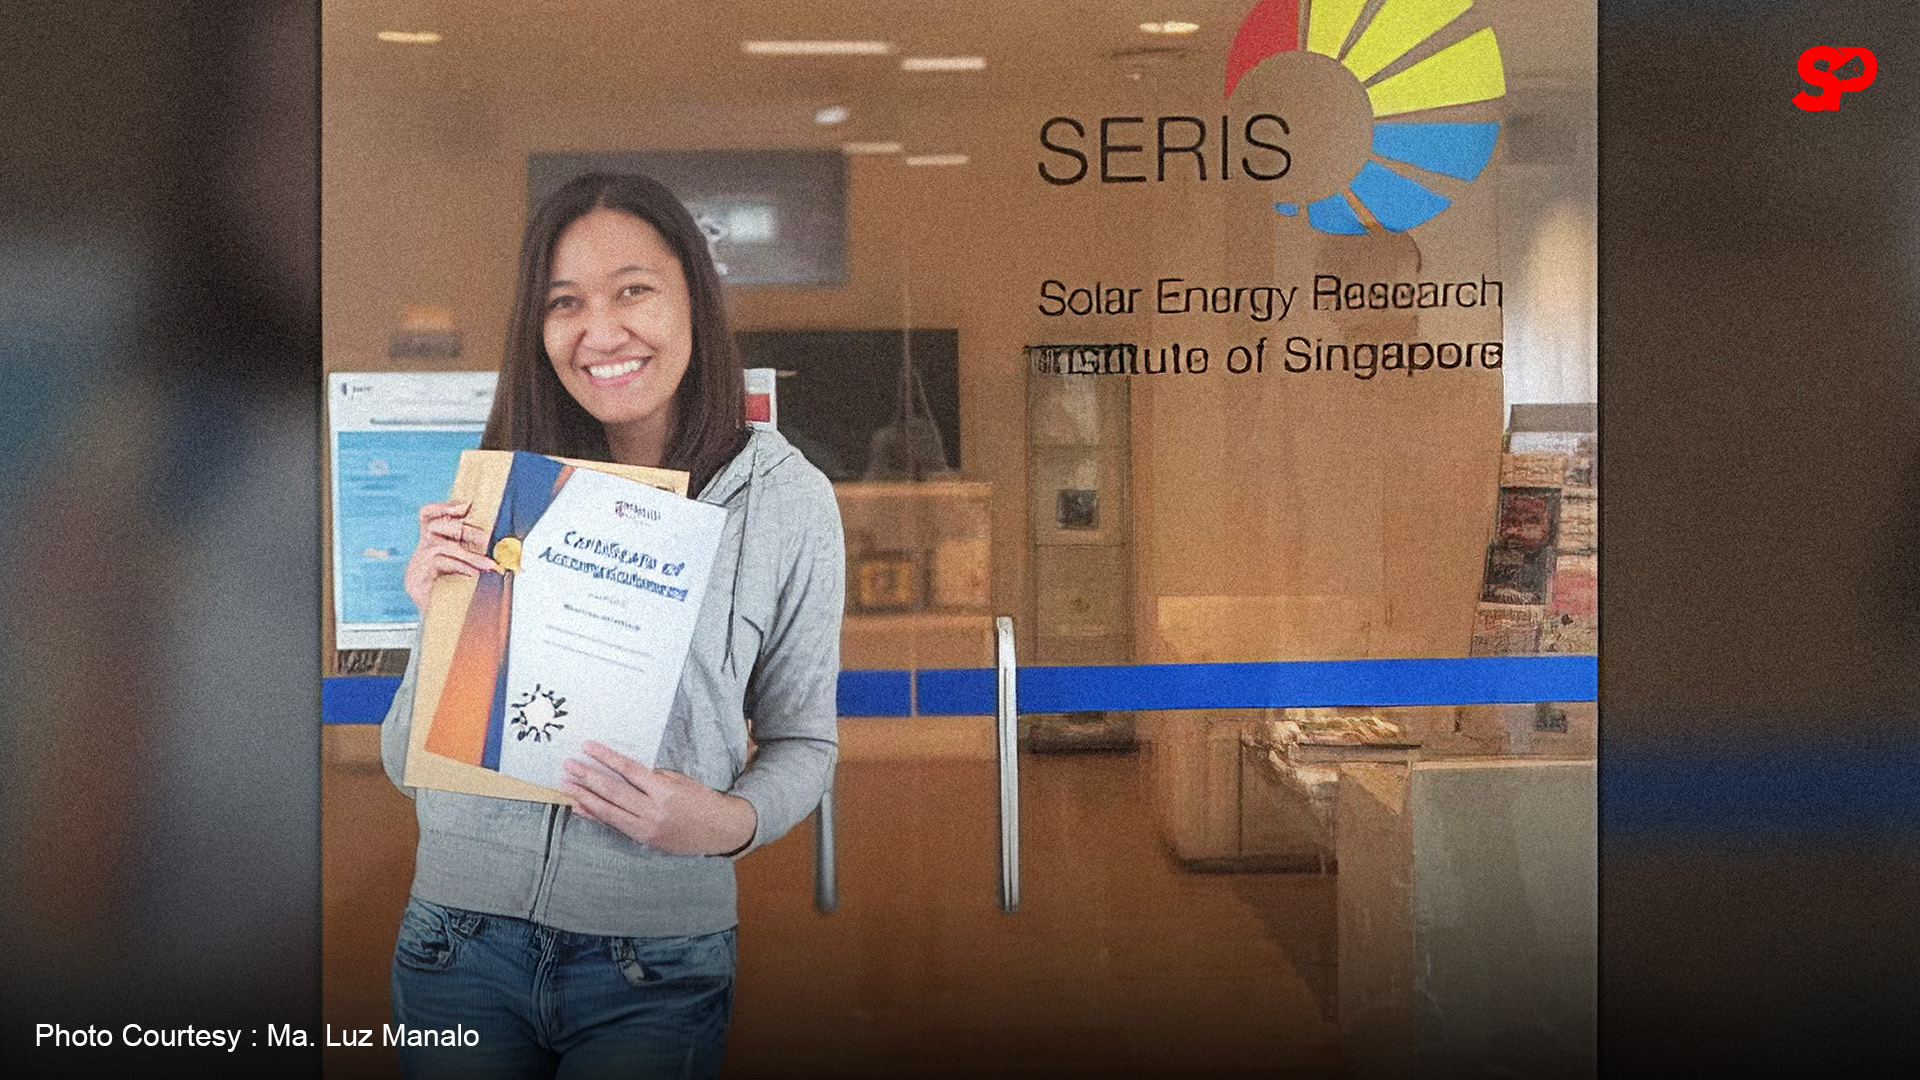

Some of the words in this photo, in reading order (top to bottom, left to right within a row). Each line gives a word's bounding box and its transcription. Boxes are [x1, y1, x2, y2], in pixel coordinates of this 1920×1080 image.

[1037, 113, 1292, 186] SERIS
[1038, 280, 1142, 316] Solar
[1157, 278, 1299, 323] Energy
[1313, 274, 1503, 311] Research
[1227, 337, 1268, 374] of
[1284, 336, 1503, 380] Singapore
